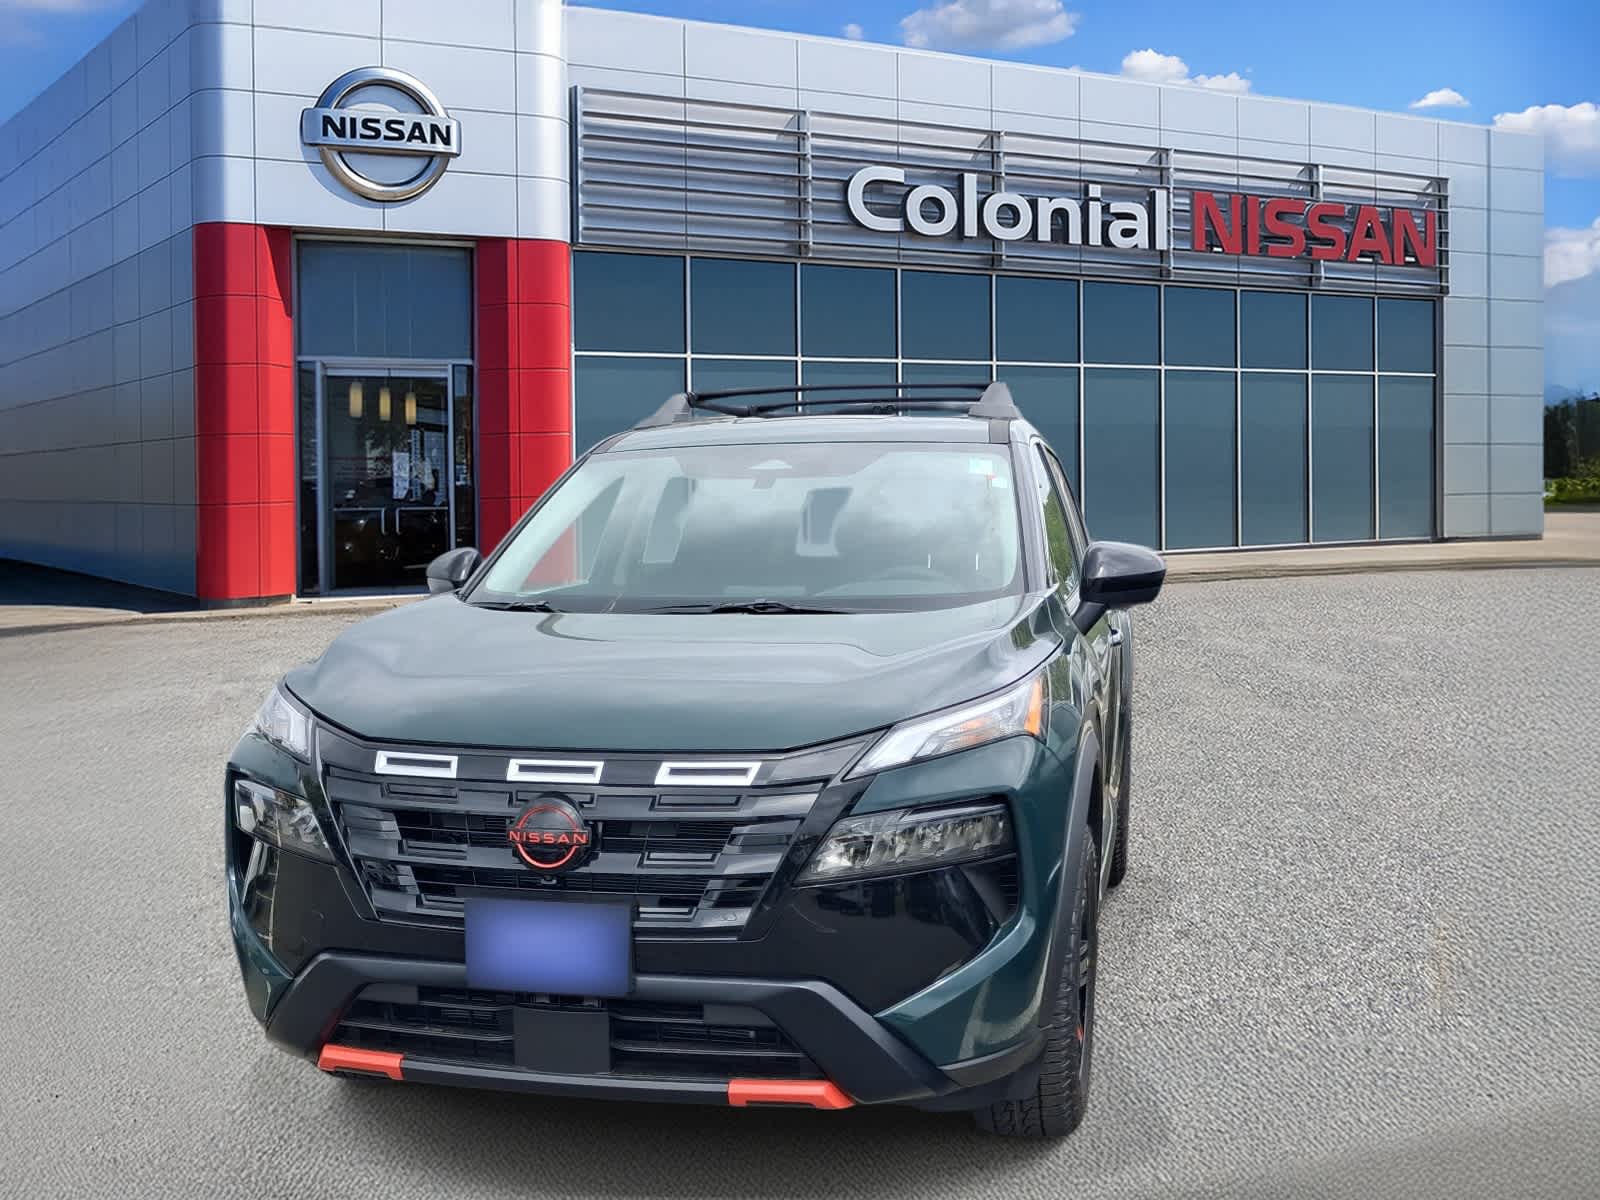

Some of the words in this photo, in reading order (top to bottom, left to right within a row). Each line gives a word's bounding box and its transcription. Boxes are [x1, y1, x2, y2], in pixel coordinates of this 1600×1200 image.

[322, 115, 452, 146] NISSAN
[846, 165, 1168, 251] Colonial
[1192, 190, 1437, 267] NISSAN
[509, 831, 587, 844] NISSAN
